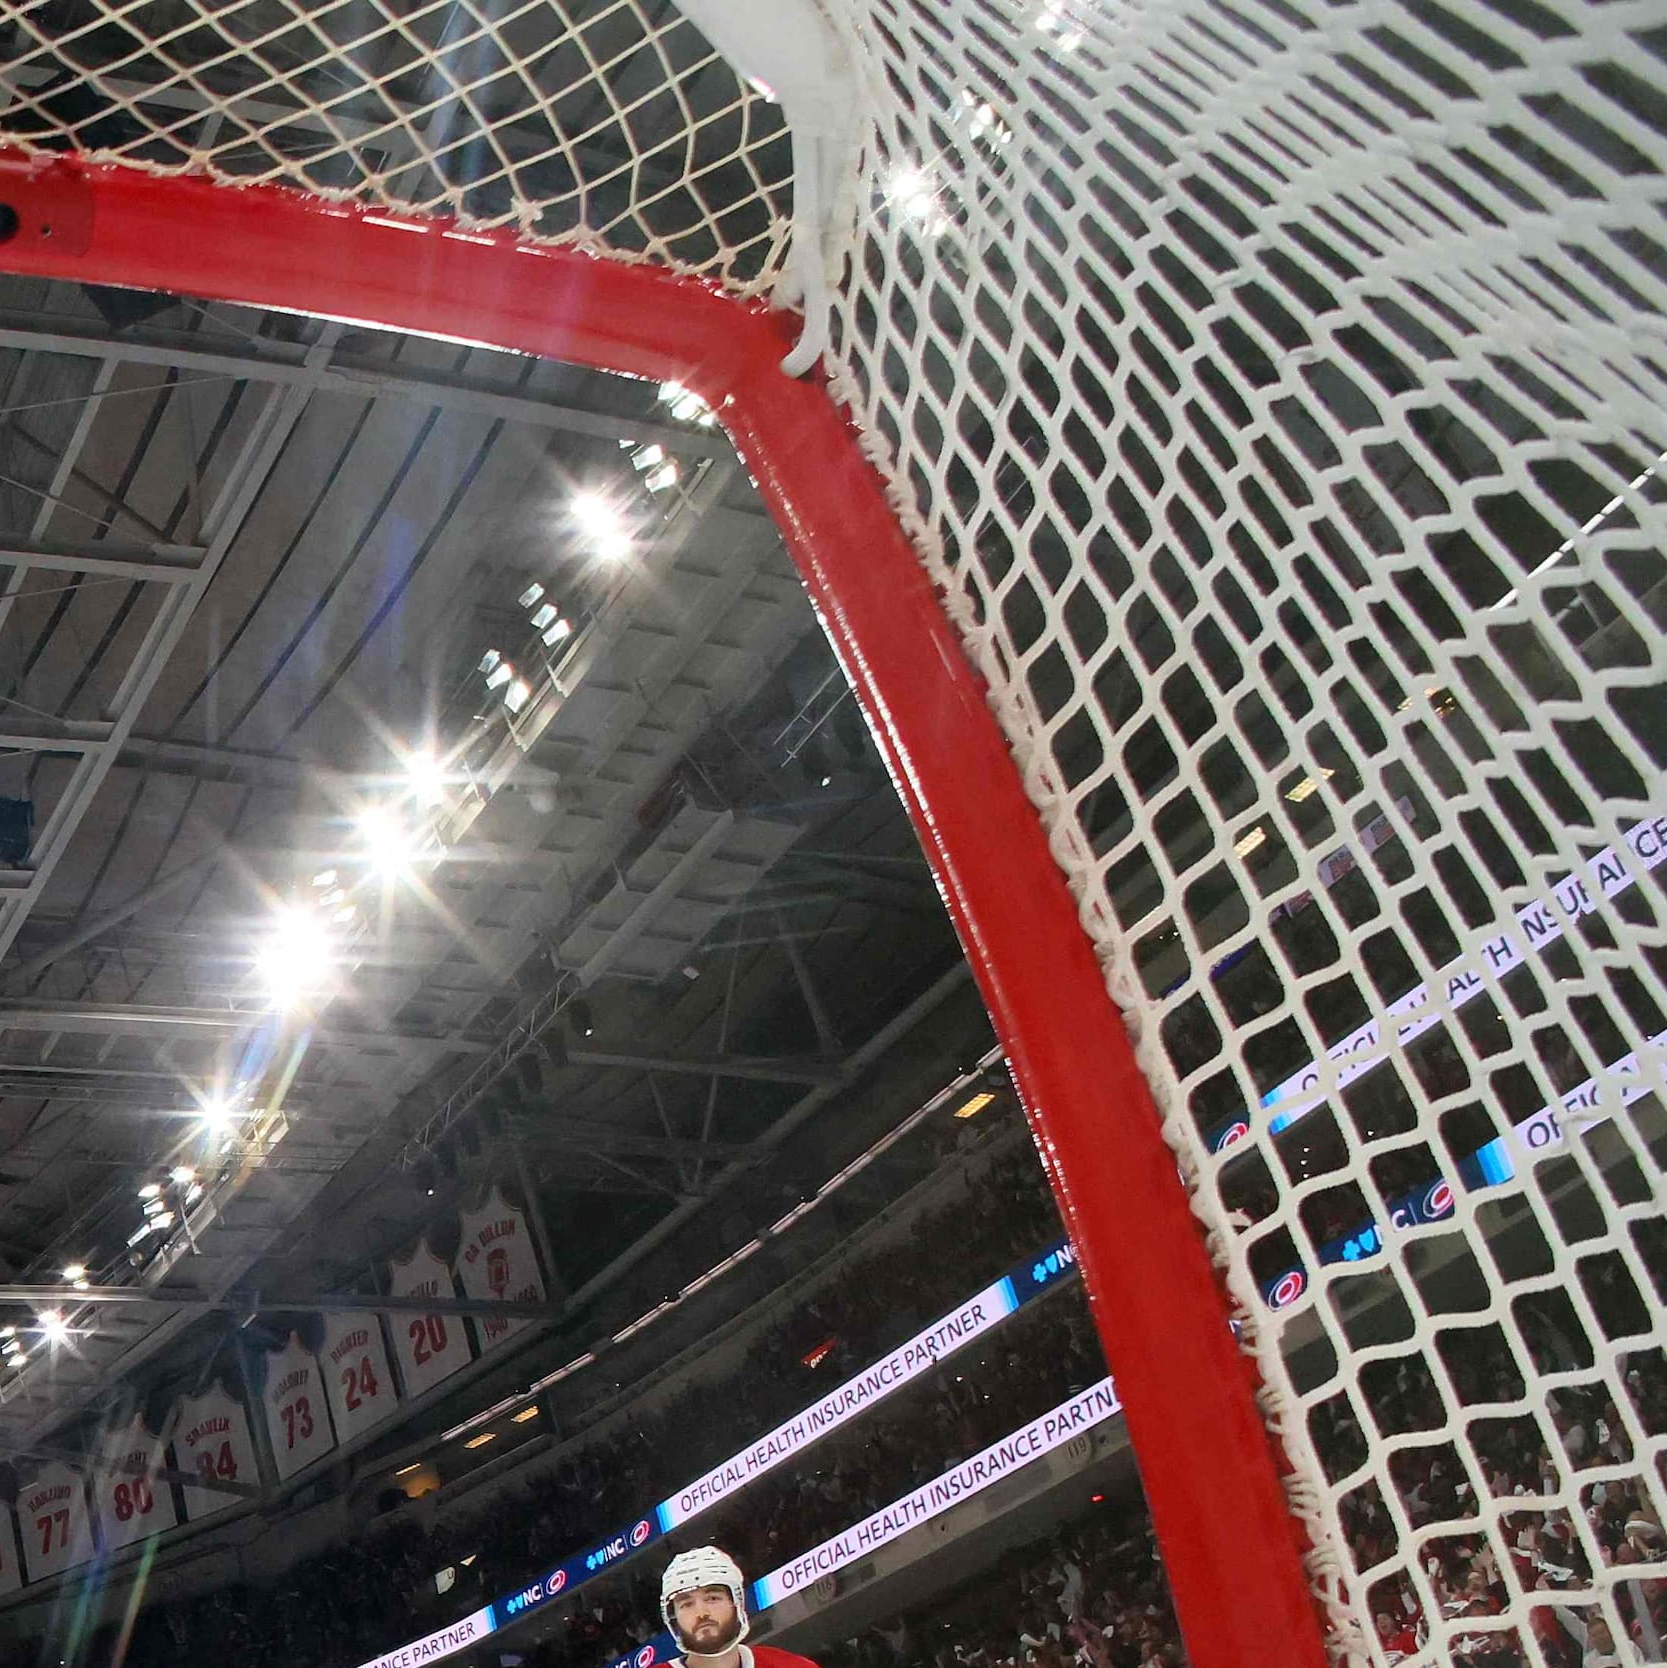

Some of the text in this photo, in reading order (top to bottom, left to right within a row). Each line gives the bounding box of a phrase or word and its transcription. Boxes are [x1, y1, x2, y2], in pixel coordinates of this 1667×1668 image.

[409, 1314, 448, 1365] 20
[341, 1356, 378, 1412] 24
[680, 1302, 987, 1514] OFFICIAL HEALTH INSURANCE PARTNER
[281, 1396, 315, 1448] 73
[114, 1476, 153, 1521] 80
[782, 1427, 1042, 1591] OFFICIAL HEALTH INSURANCE
[37, 1508, 73, 1554] 77
[412, 1621, 475, 1662] PARTNER
